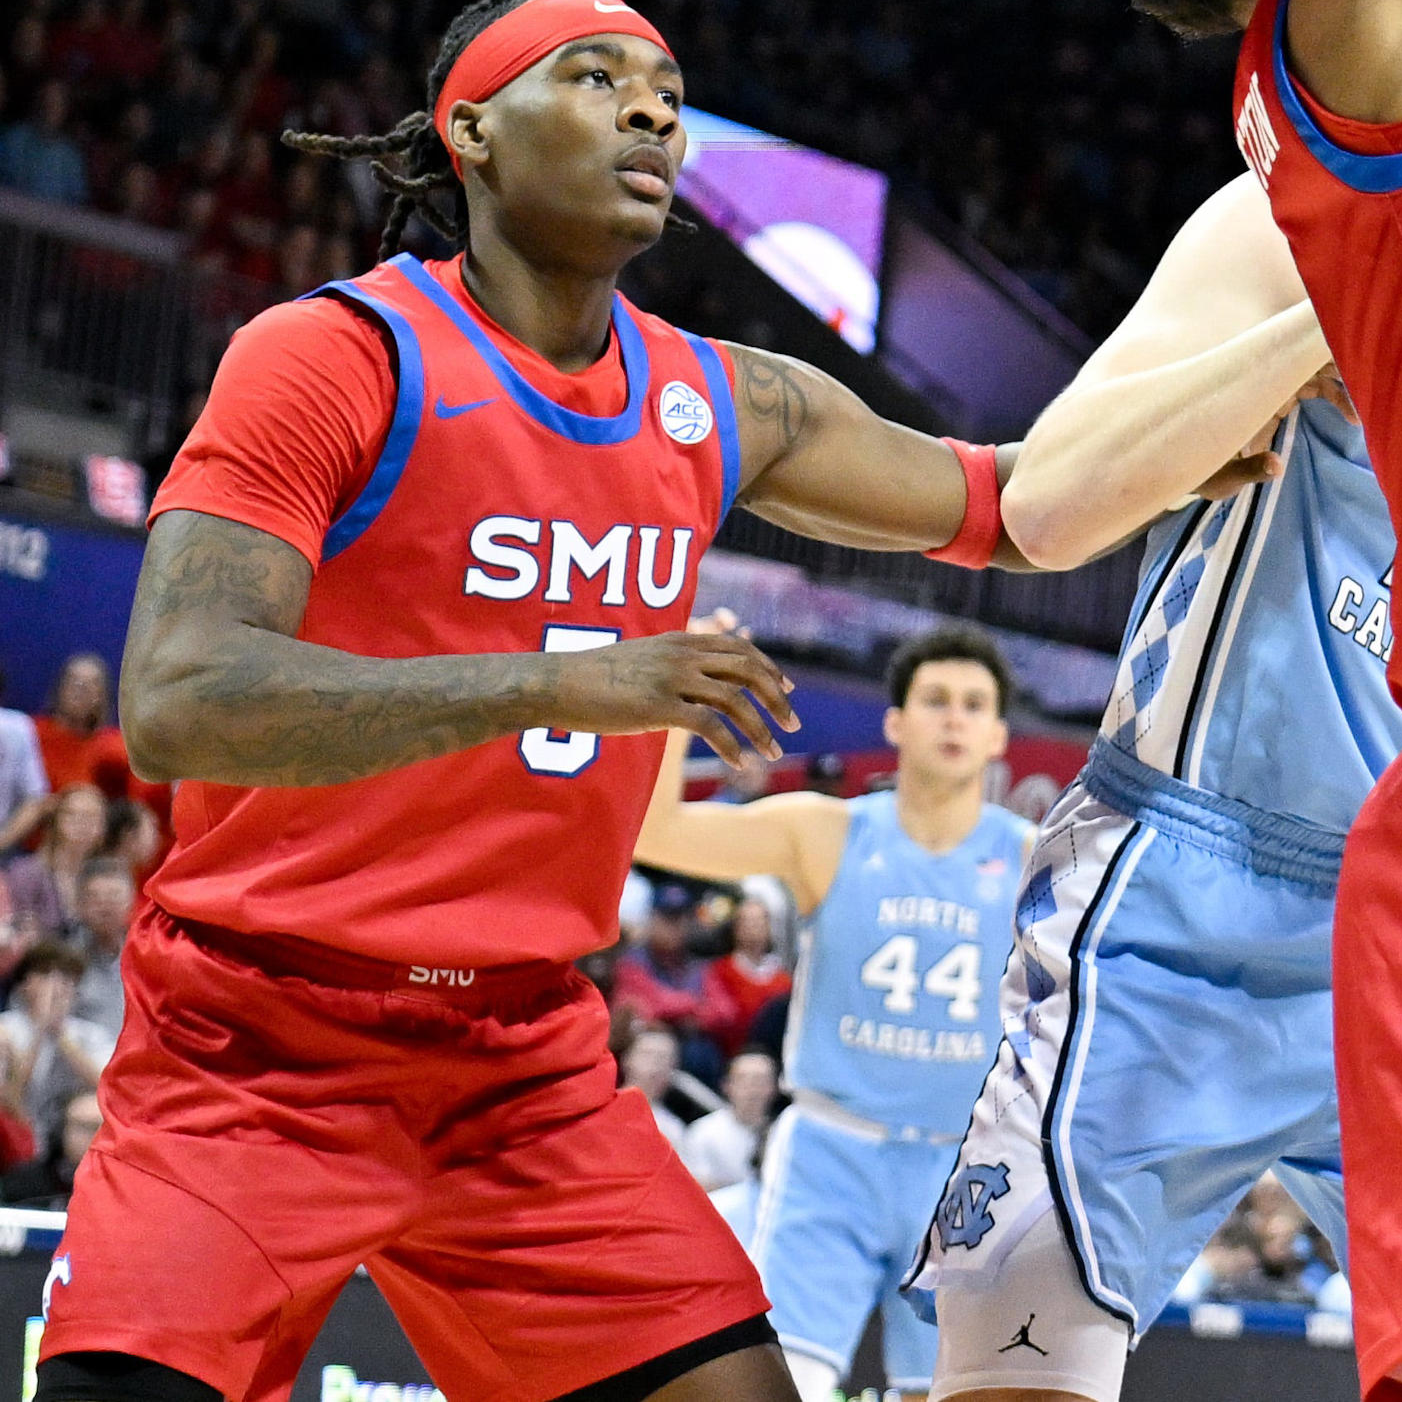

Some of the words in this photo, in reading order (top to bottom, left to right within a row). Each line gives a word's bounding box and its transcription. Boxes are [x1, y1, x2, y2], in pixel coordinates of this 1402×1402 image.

[667, 402, 705, 417] ACC
[463, 515, 694, 610] SMU
[877, 896, 981, 936] NORTH
[860, 932, 983, 1023] 44
[839, 1014, 988, 1062] CAROLINA
